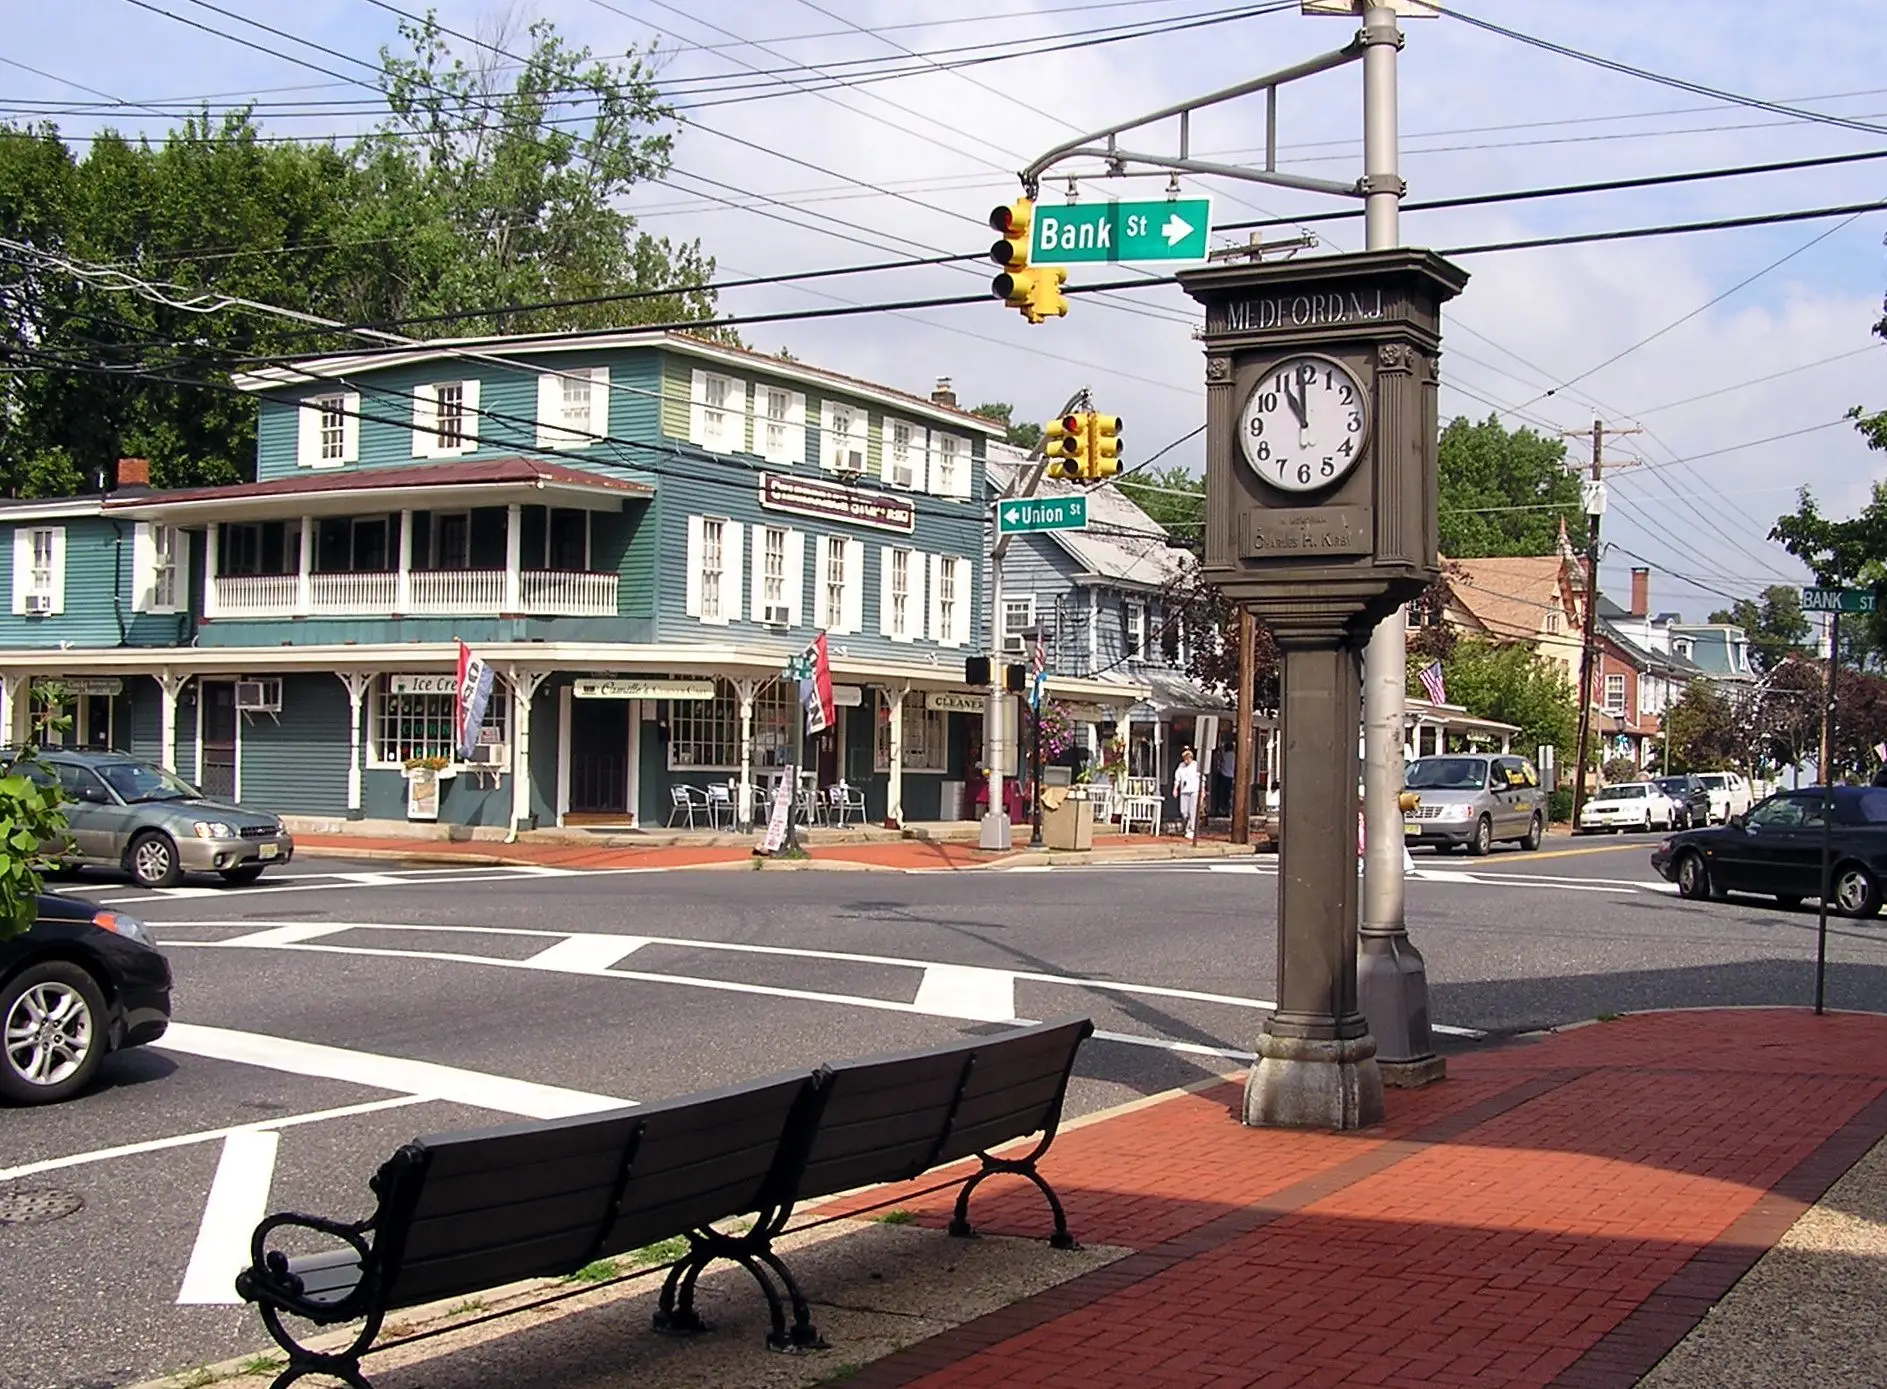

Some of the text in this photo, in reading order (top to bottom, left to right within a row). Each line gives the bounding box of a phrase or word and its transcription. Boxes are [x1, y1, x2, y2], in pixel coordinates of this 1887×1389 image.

[1040, 215, 1147, 250] Bank St
[1296, 364, 1317, 386] 12
[1326, 369, 1334, 391] 1
[1258, 392, 1278, 413] 10
[1339, 385, 1353, 406] 2
[1250, 417, 1264, 438] 9
[1347, 411, 1361, 433] 3
[1257, 440, 1271, 461] 8
[1336, 437, 1354, 458] 4
[1275, 458, 1289, 479] 7
[1297, 464, 1311, 484] 6
[1320, 456, 1335, 477] 5
[1022, 503, 1082, 524] Union St
[1803, 591, 1876, 610] BANK ST
[412, 678, 432, 692] Ice
